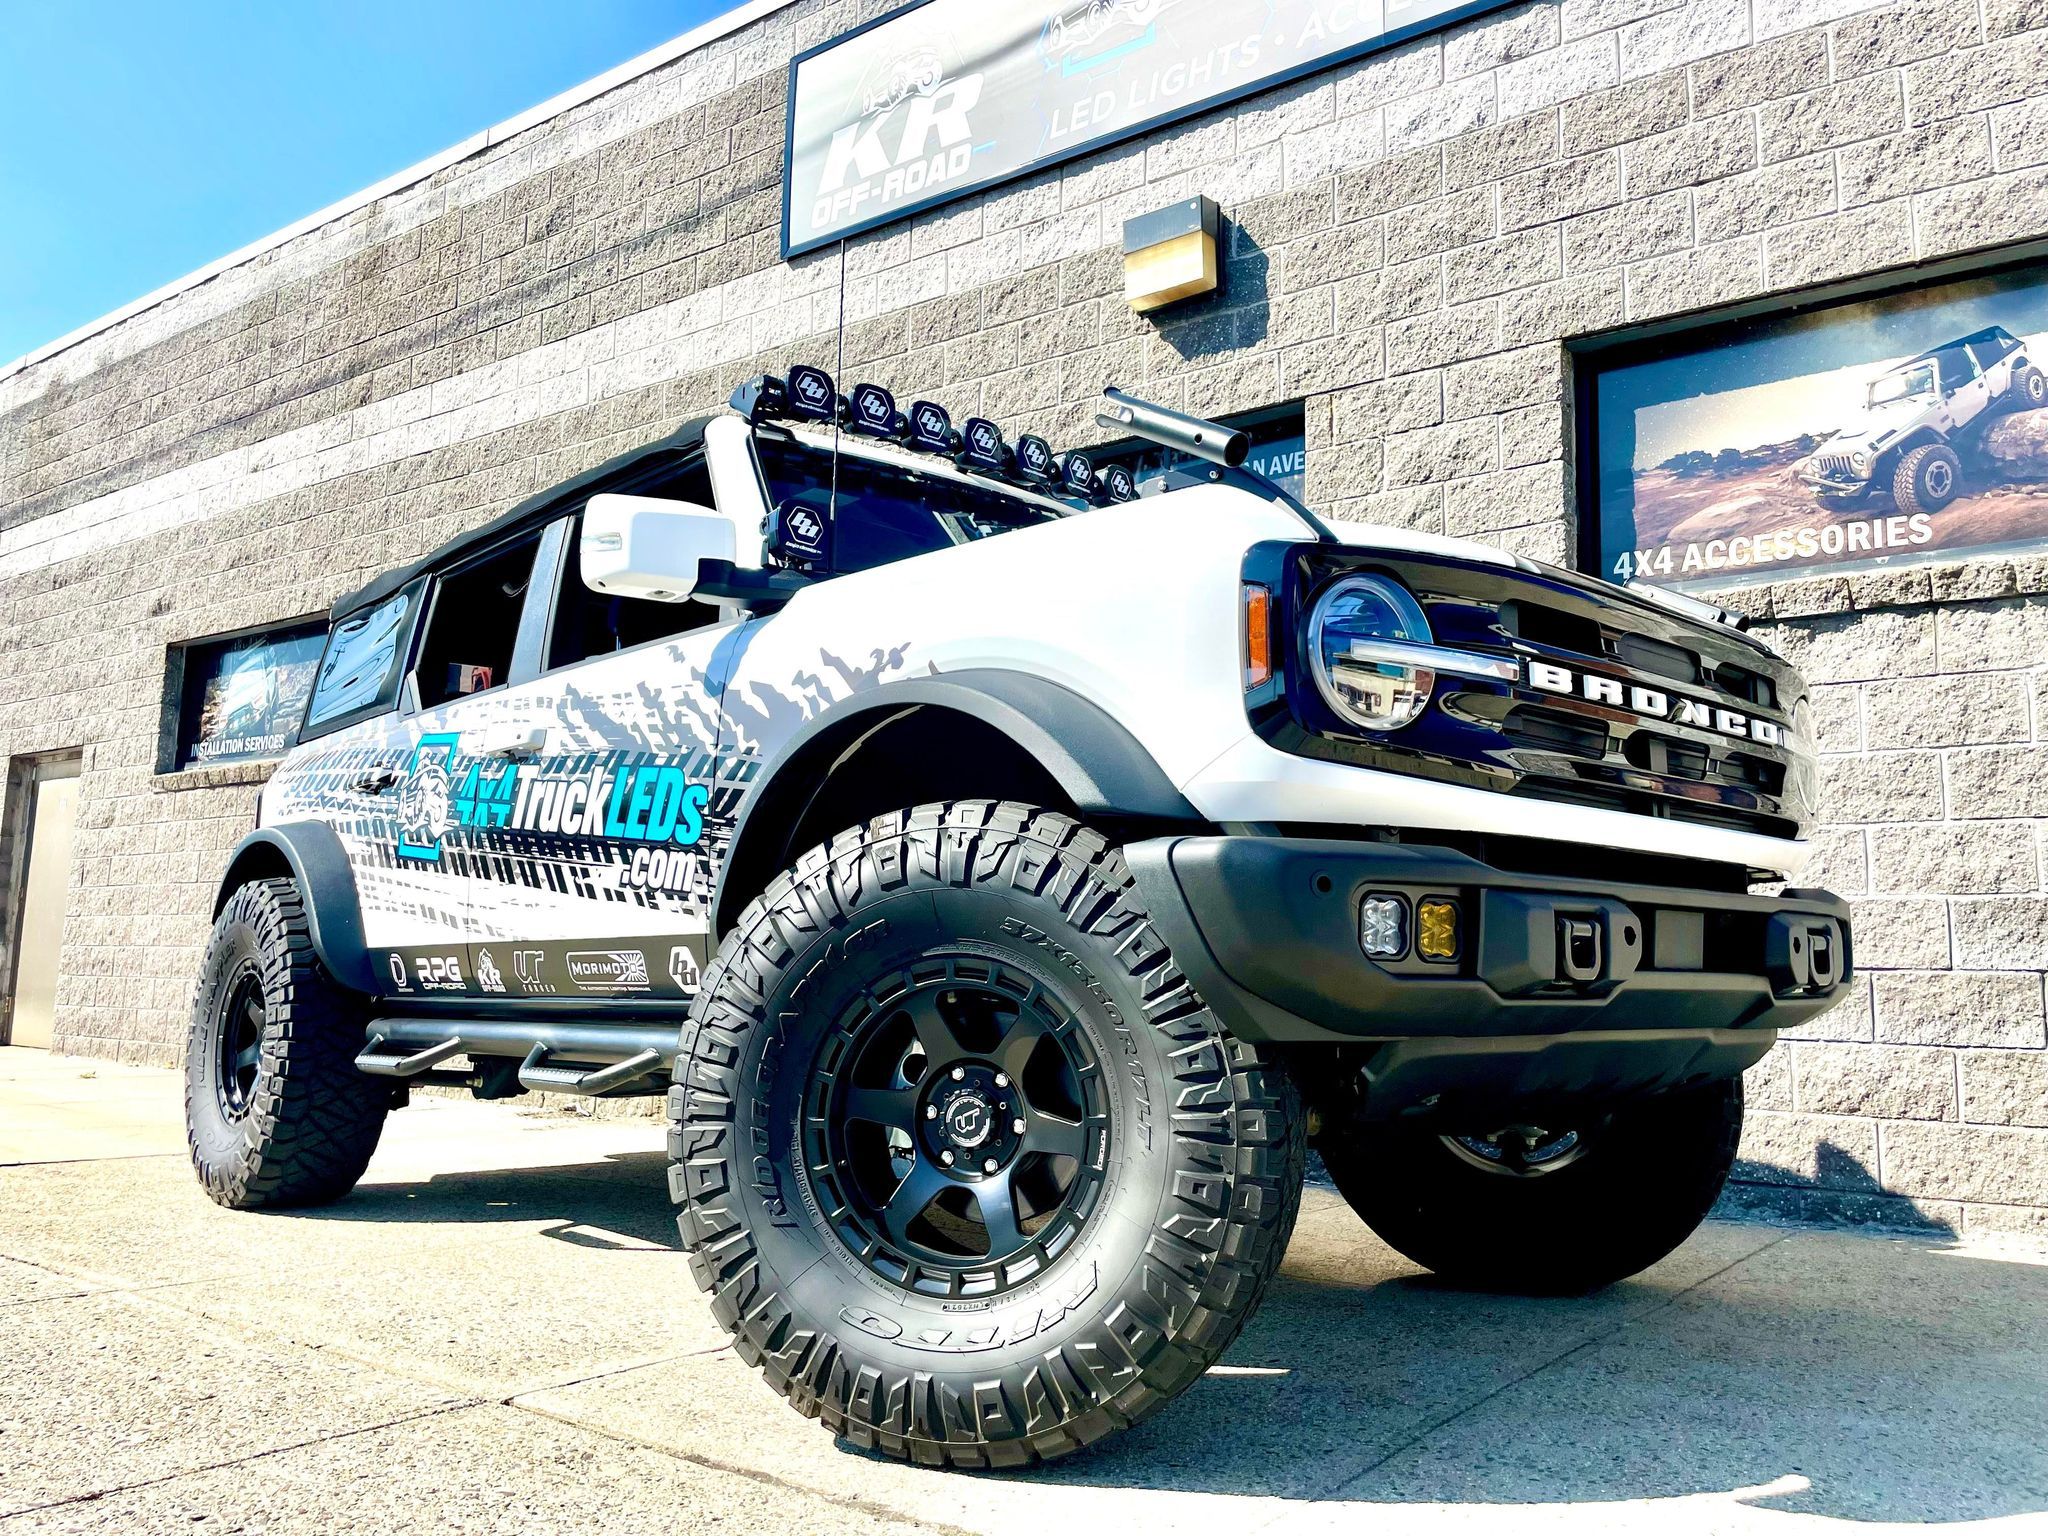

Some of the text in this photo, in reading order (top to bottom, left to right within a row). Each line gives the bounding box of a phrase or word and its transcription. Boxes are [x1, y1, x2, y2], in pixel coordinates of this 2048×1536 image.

[1048, 89, 1115, 140] LED
[1129, 33, 1263, 103] LIGHTS
[817, 72, 984, 196] KR
[810, 142, 973, 229] OFF-ROAD
[1269, 450, 1306, 476] AVE
[1612, 512, 1933, 580] 4X4 ACCESSORIES
[1528, 660, 1785, 747] BRONCO
[190, 733, 285, 758] INSTALLATION SERVICES
[621, 848, 698, 892] .com
[415, 956, 463, 982] RPG
